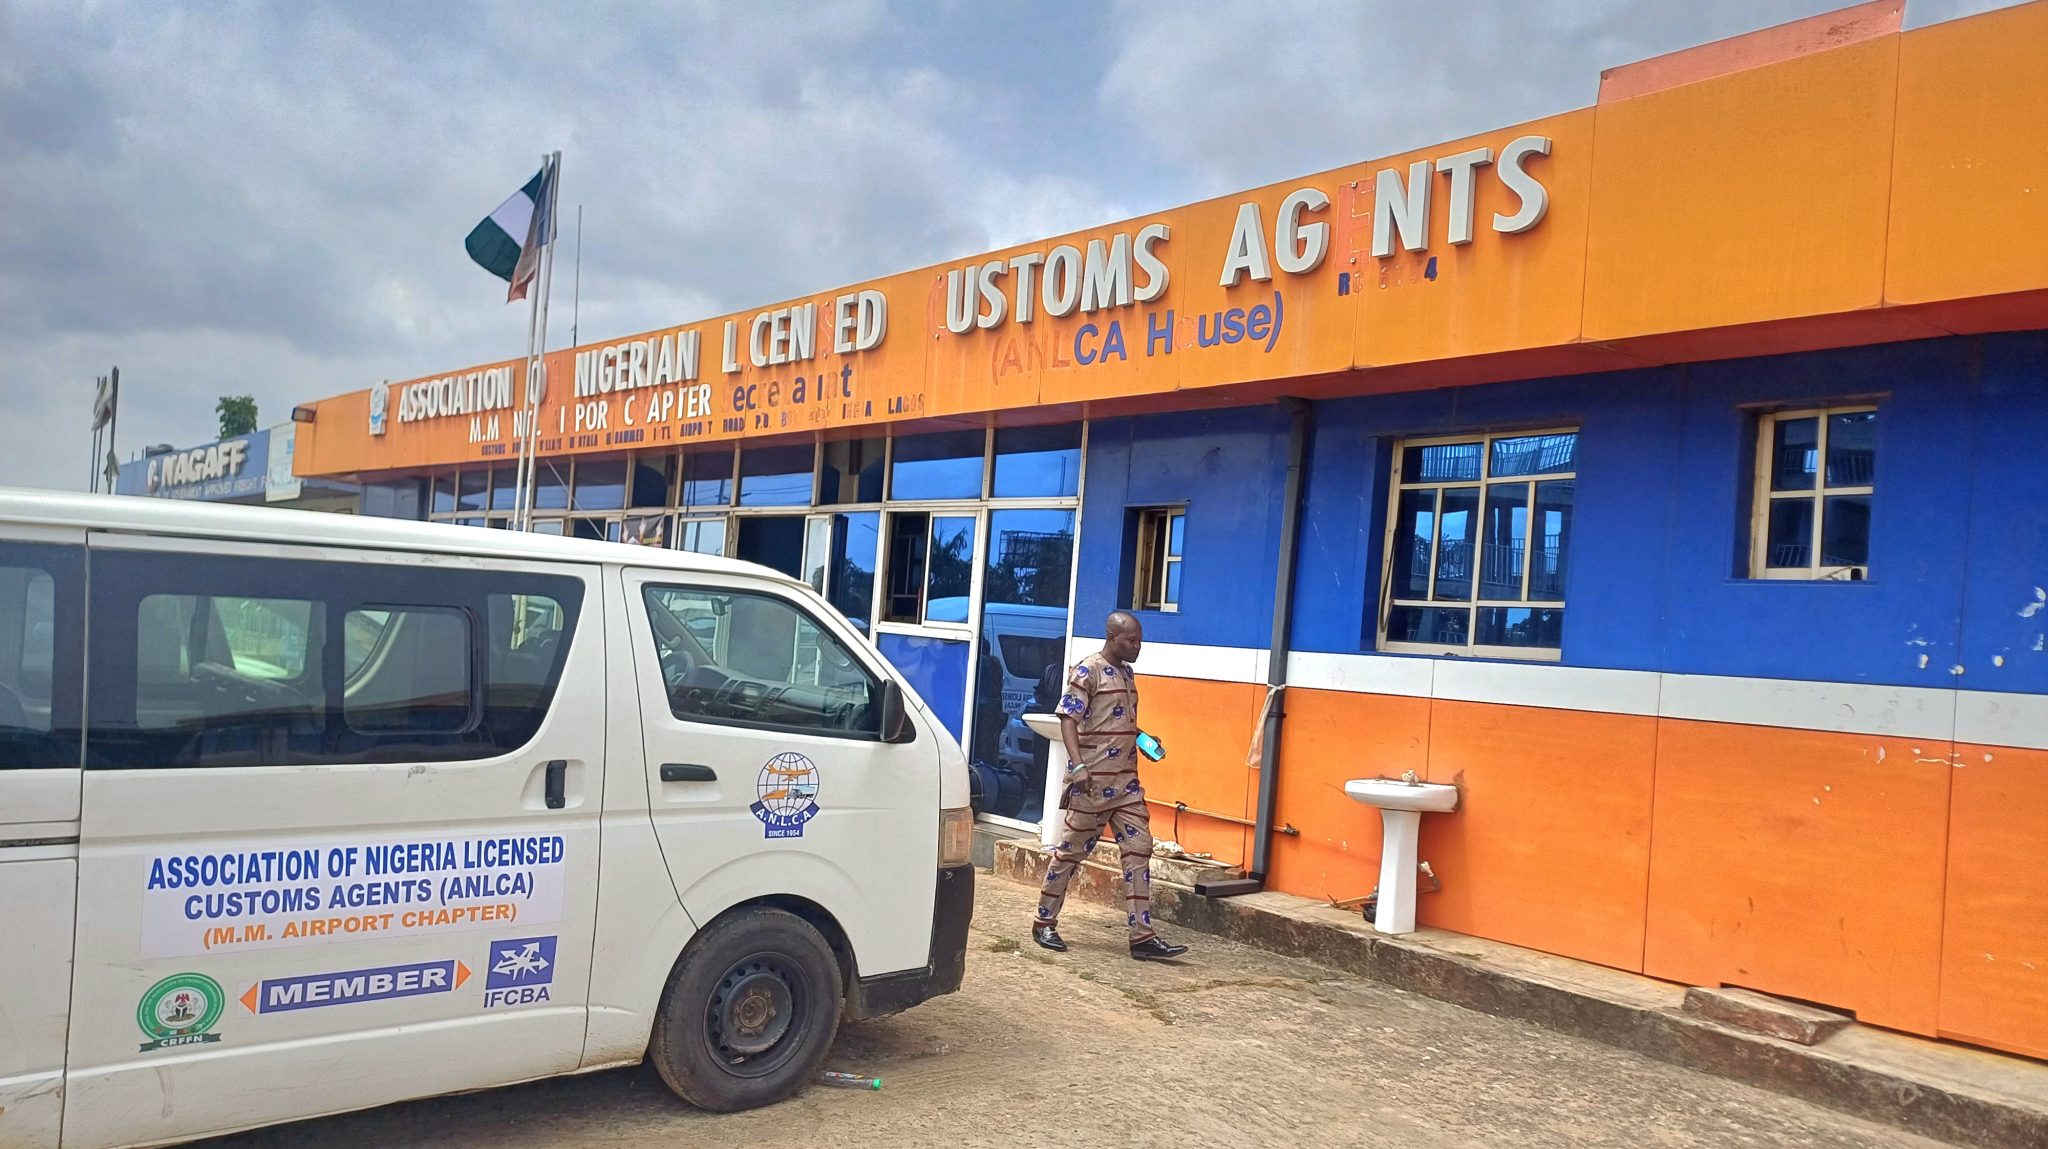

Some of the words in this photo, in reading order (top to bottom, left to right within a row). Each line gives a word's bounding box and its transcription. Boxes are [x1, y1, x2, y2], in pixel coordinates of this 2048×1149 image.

[398, 366, 514, 423] ASSOCIATION
[574, 328, 700, 398] NIGERIAN
[161, 439, 249, 487] NAGAFF
[147, 849, 319, 890] ASSOCIATION
[328, 847, 358, 878] OF
[365, 841, 455, 876] NIGERIA
[463, 836, 564, 869] LICENSED
[184, 883, 321, 920] CUSTOMS
[328, 879, 432, 910] AGENTS
[439, 872, 535, 906] (ANLCA)
[202, 924, 273, 950] (M.M.
[282, 913, 394, 940] AIRPORT
[401, 903, 518, 928] CHAPTER)
[268, 967, 447, 1007] MEMBER
[483, 987, 552, 1009] IFCBA
[160, 1034, 203, 1047] CRFFN
